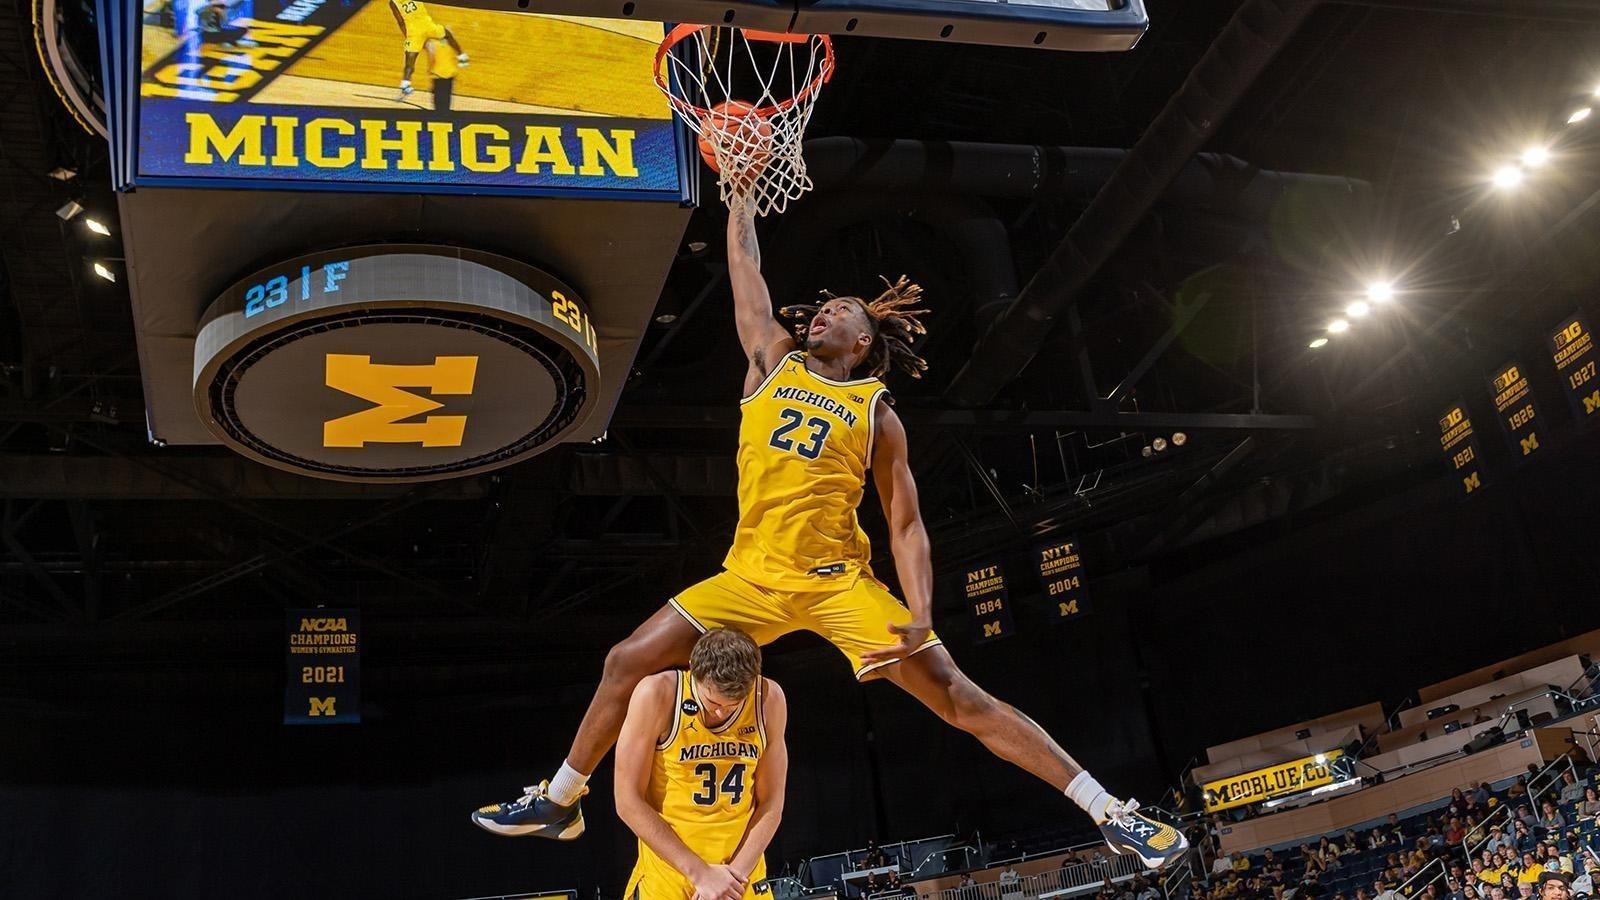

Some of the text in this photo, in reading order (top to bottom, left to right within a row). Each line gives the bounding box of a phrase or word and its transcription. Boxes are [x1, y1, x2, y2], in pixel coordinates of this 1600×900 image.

[185, 112, 638, 177] MICHIGAN
[244, 274, 288, 319] 23
[323, 261, 350, 293] F
[552, 290, 581, 333] 23
[1569, 361, 1597, 389] 1927
[323, 353, 479, 448] M
[772, 387, 858, 429] MICHIGAN
[1582, 389, 1600, 415] M
[1508, 404, 1535, 430] 1926
[768, 407, 832, 461] 23
[1519, 432, 1540, 456] M
[1452, 445, 1475, 469] 1921
[1463, 471, 1481, 493] M
[1040, 554, 1080, 571] CHAMPIONS
[1041, 543, 1073, 562] NIT
[965, 576, 1003, 592] CHAMPIONS
[967, 565, 998, 583] NIT
[1048, 576, 1080, 596] 2004
[975, 598, 1003, 616] 1984
[1058, 599, 1079, 617] M
[300, 618, 347, 632] NCAA
[983, 620, 1002, 638] M
[290, 634, 357, 645] CHAMPIONS
[290, 645, 356, 654] WOMEN'S GYMNASTICS
[302, 666, 345, 683] 2021
[308, 696, 337, 717] M
[679, 741, 759, 762] MICHIGAN
[692, 762, 747, 807] 34
